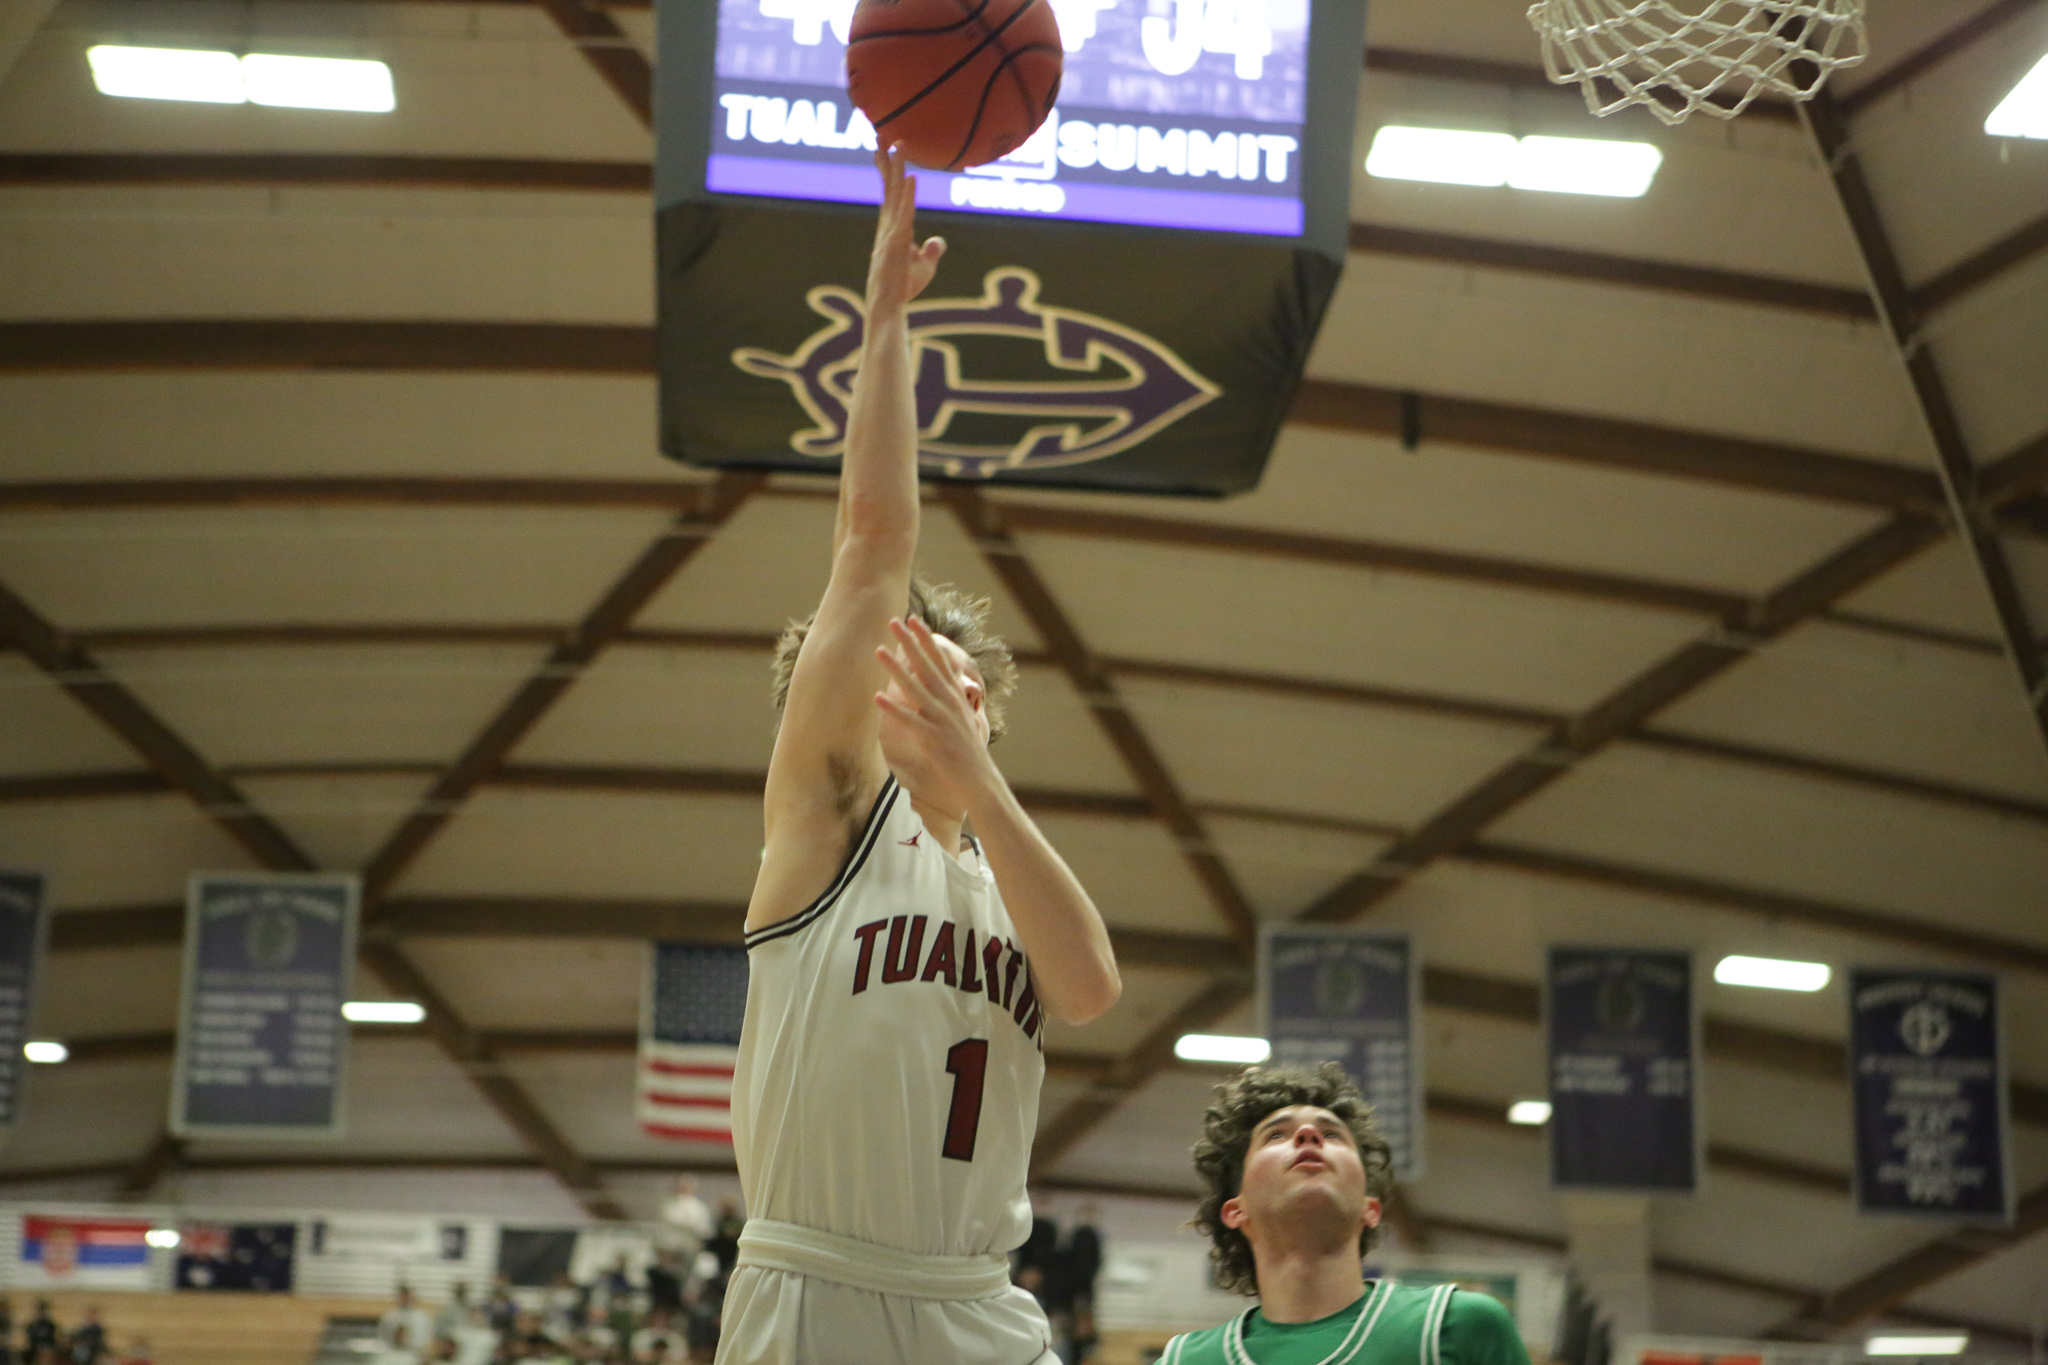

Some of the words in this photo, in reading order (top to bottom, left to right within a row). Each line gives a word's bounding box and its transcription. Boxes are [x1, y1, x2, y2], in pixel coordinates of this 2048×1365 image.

[719, 93, 879, 151] TUALA
[1056, 120, 1298, 183] SUMMIT
[941, 1037, 989, 1162] 1
